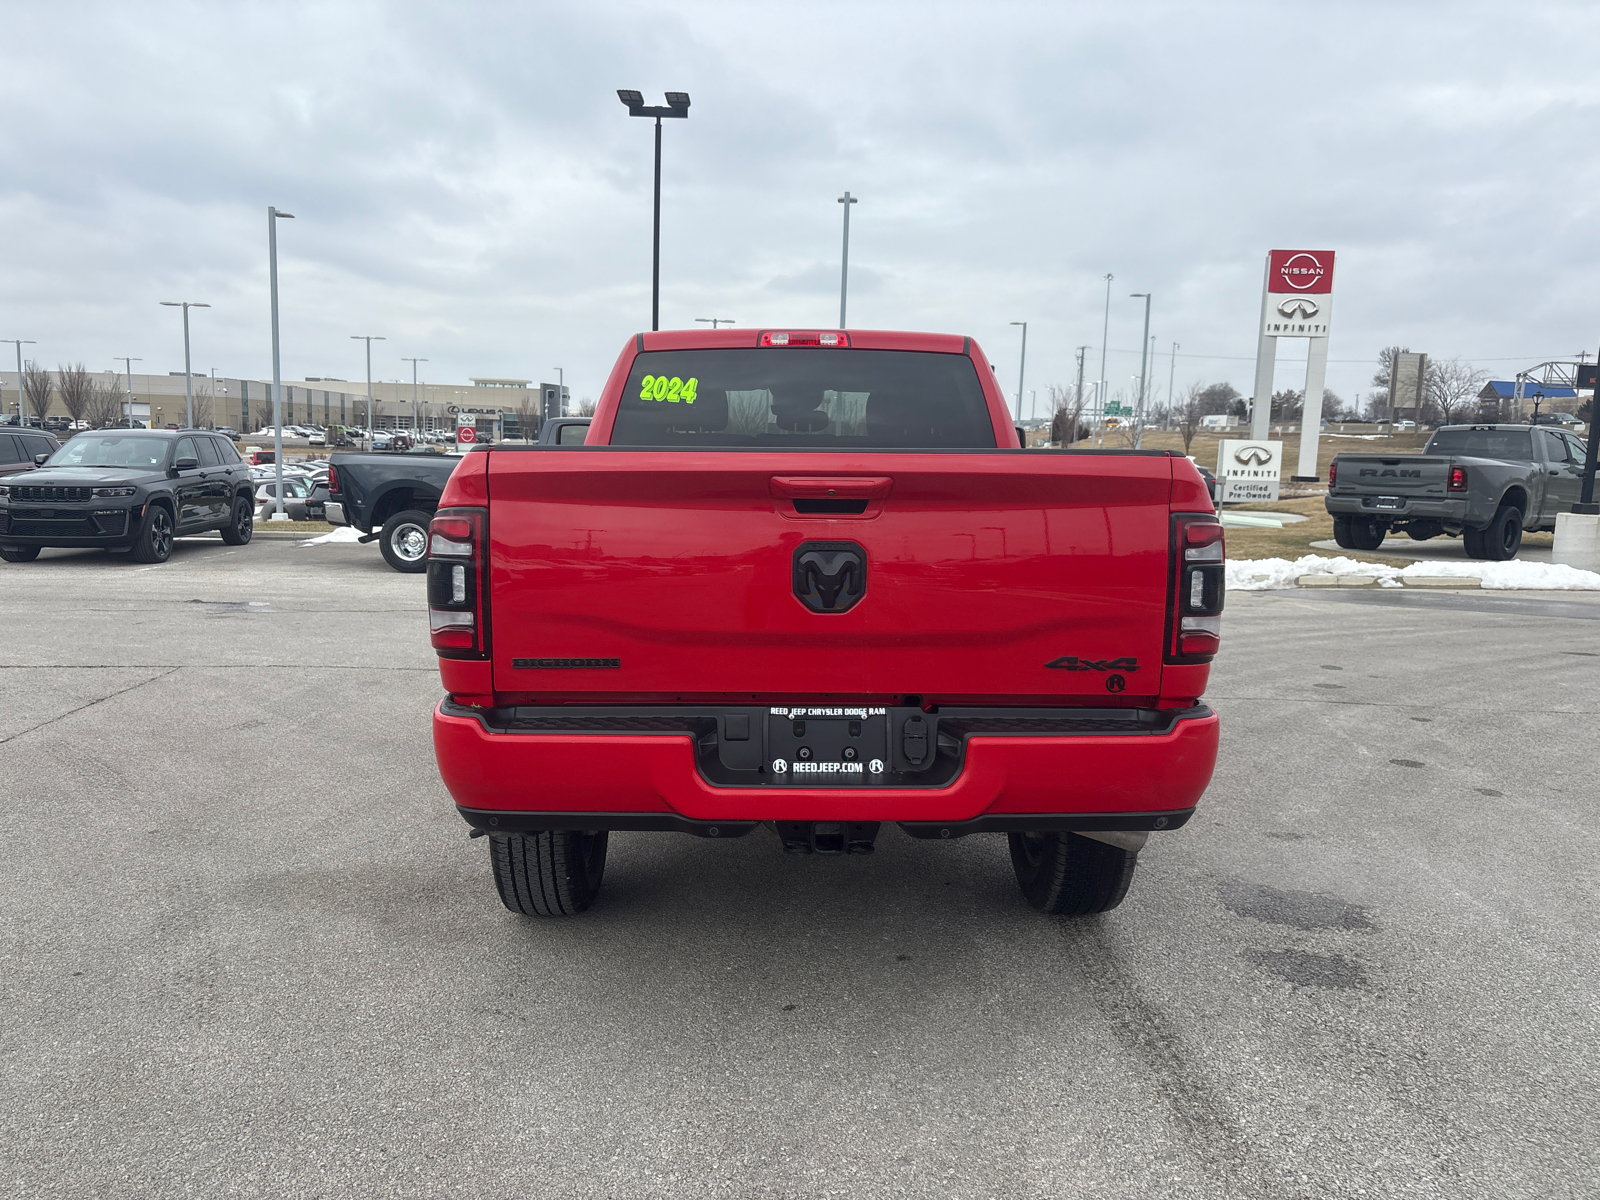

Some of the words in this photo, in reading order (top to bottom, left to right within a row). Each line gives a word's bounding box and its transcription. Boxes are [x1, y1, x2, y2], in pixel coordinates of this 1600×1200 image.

[1267, 324, 1326, 332] INFINITI
[639, 374, 699, 405] 2024
[1227, 469, 1277, 478] INFINITI
[1360, 468, 1422, 478] RAM
[1233, 484, 1268, 492] Certified
[1228, 491, 1272, 499] Pre-Owned
[1043, 656, 1142, 671] 4x4
[770, 707, 788, 715] REED
[789, 708, 806, 716] JEEP
[807, 708, 843, 716] CHRYSLER
[844, 708, 867, 716] DODGE
[868, 707, 886, 715] RAM
[793, 762, 863, 773] REEDJEEP.COM
